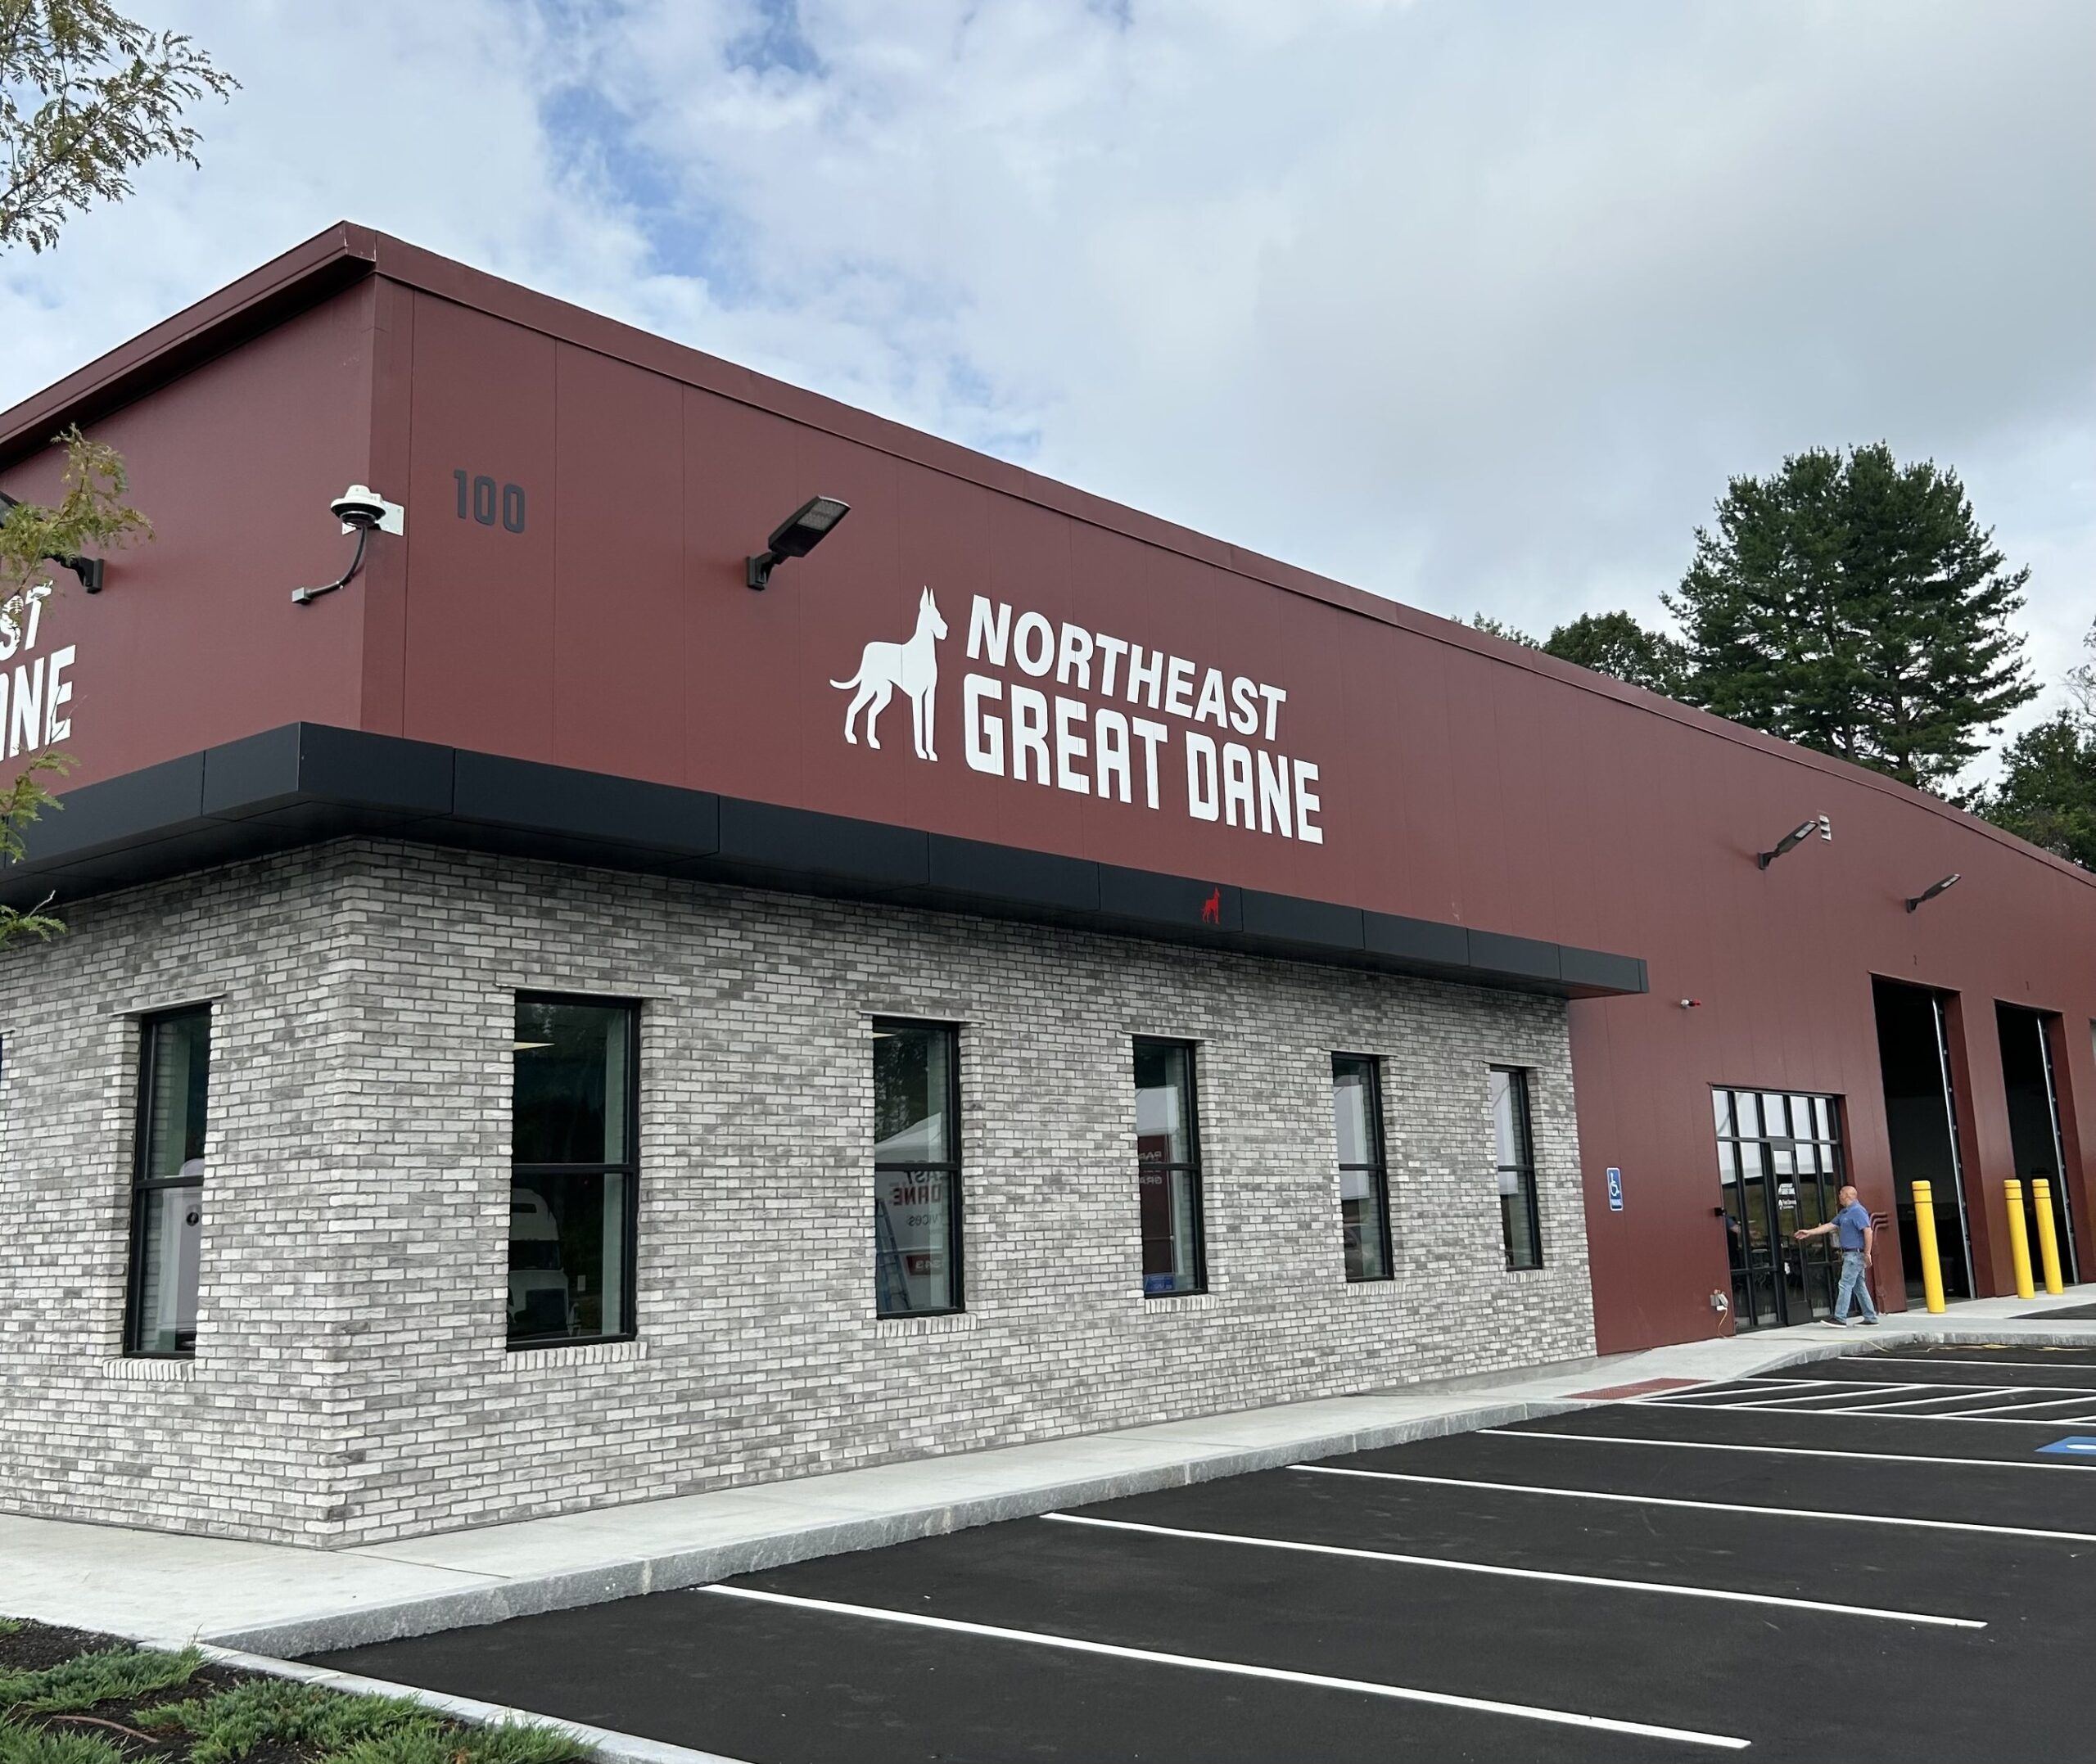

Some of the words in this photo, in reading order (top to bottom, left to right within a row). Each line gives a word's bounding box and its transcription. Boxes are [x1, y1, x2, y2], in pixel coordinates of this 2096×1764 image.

[454, 469, 525, 534] 100
[966, 594, 1287, 742] NORTHEAST
[963, 673, 1168, 810] GREAT
[1186, 730, 1323, 845] DANE
